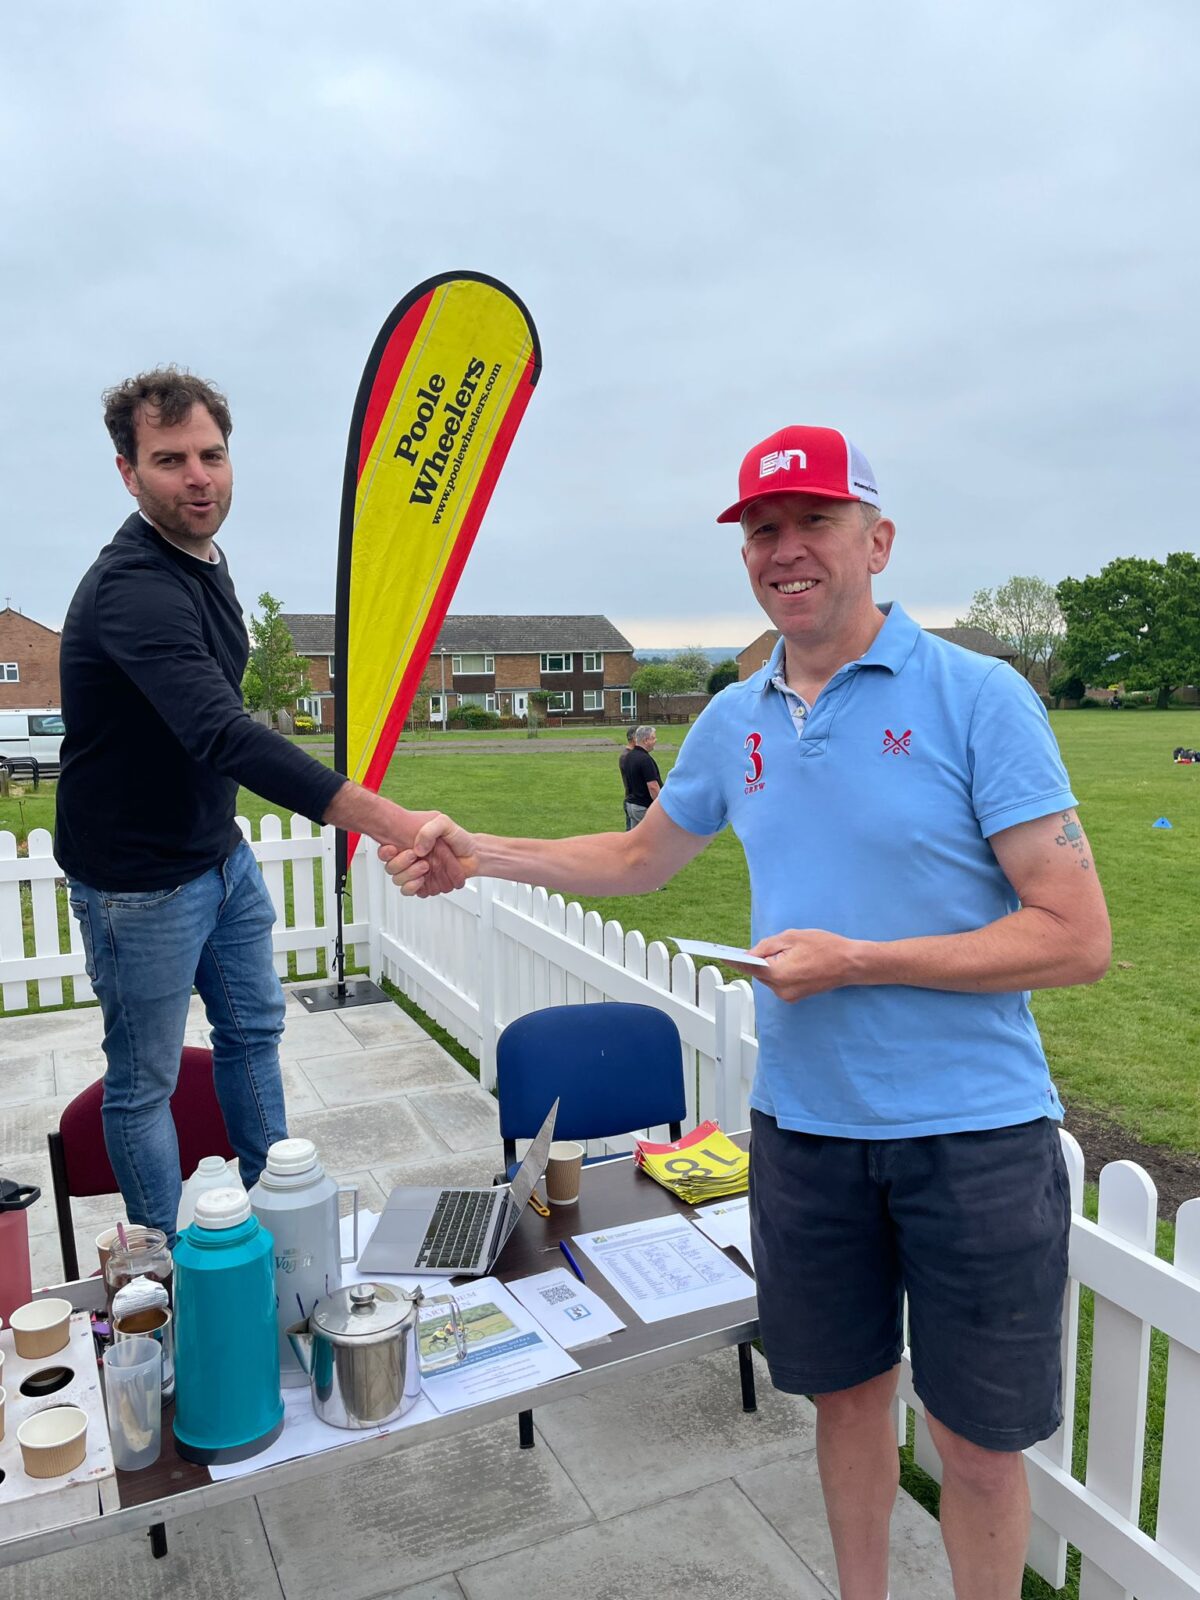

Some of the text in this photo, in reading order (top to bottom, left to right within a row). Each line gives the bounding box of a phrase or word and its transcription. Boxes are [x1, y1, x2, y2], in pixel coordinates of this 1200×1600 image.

[394, 373, 446, 466] Poole
[409, 357, 485, 505] Wheelers
[432, 363, 502, 525] www.poolewheelers.com
[744, 732, 763, 785] 3
[744, 782, 765, 795] CREW
